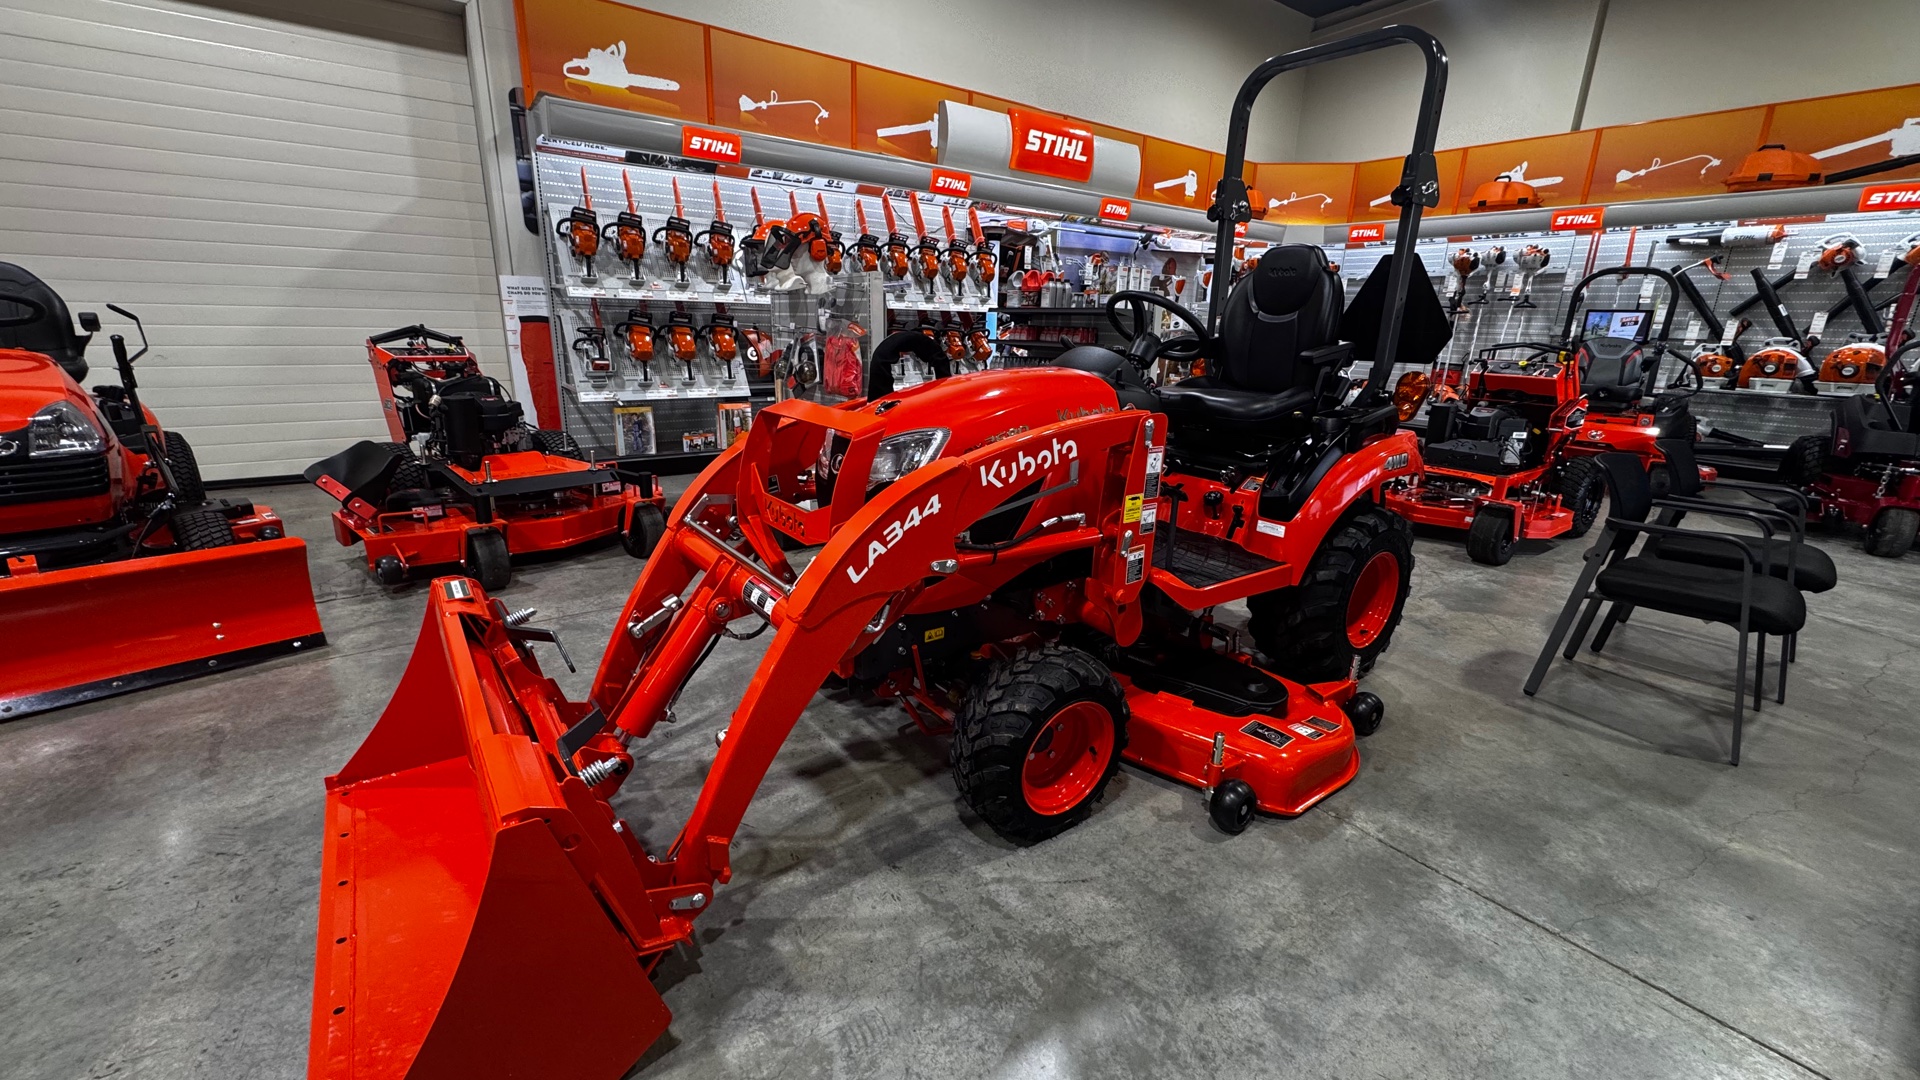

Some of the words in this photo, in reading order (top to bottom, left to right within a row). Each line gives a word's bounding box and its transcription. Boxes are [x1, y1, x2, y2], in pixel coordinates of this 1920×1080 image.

[690, 136, 737, 156] STIHL
[1025, 129, 1088, 162] STIHL
[936, 176, 968, 191] STIHL
[1866, 190, 1920, 205] STIH
[1104, 203, 1128, 216] STIHL
[1555, 214, 1597, 226] STIHL
[1351, 229, 1380, 238] STIHL
[980, 438, 1078, 488] Kubota
[1384, 453, 1408, 471] 4WD
[764, 498, 806, 538] Kubota
[846, 493, 941, 584] LA344
